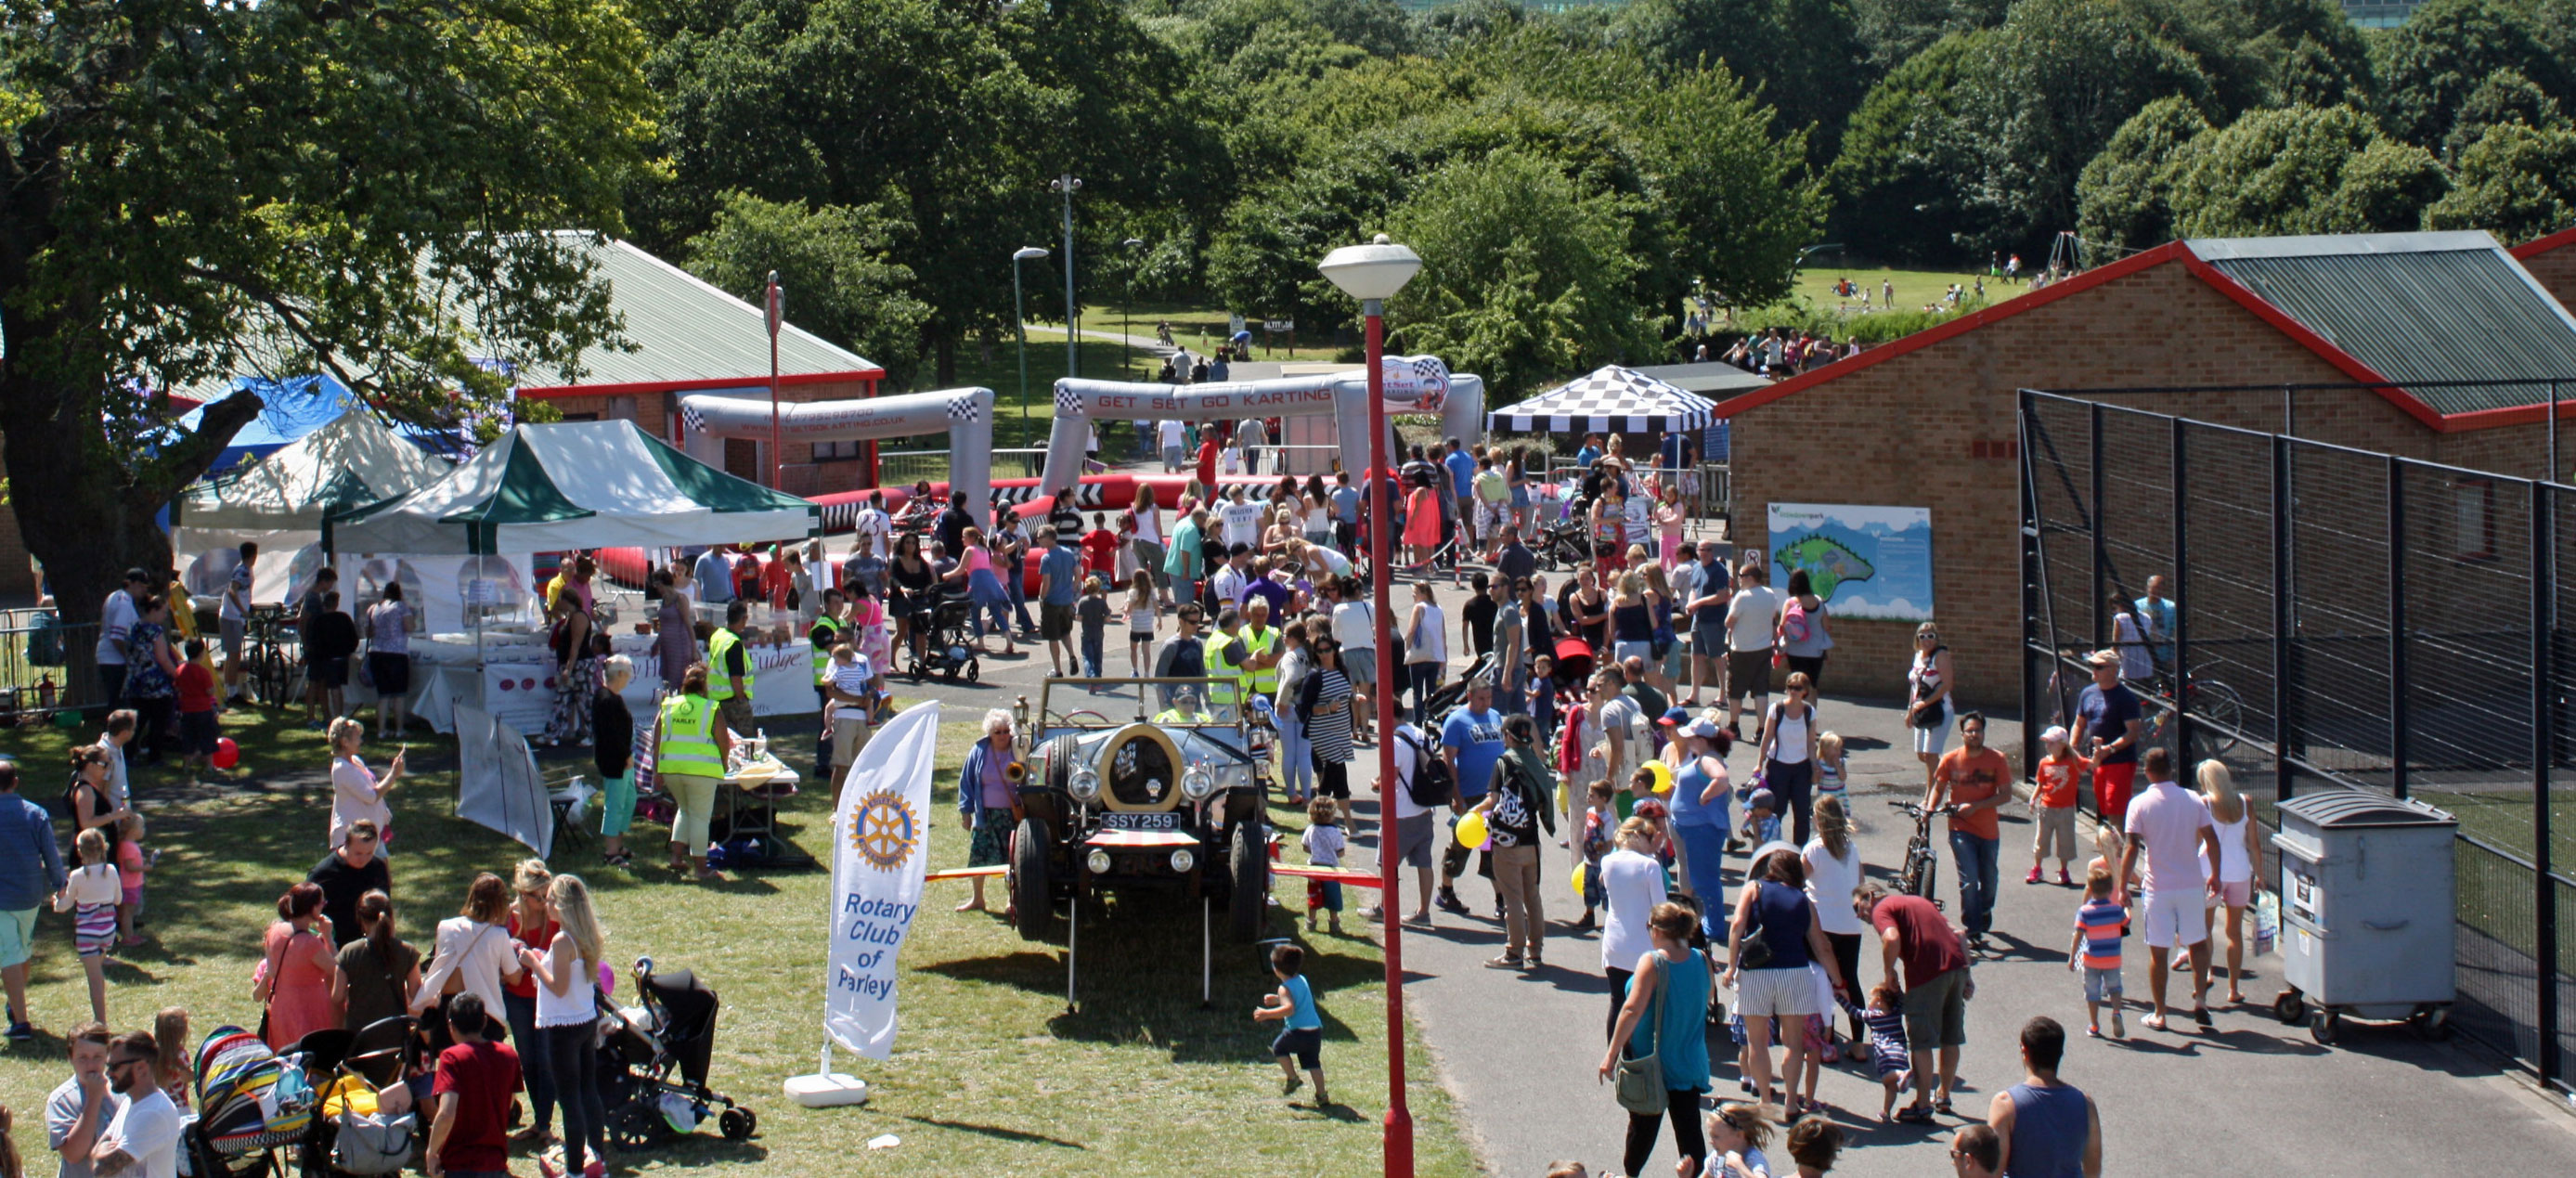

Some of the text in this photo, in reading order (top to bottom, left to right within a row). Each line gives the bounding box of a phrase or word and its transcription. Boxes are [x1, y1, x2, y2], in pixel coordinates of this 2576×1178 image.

[1099, 388, 1331, 410] GET SET GO KARTING
[861, 513, 881, 536] 23
[1224, 587, 1230, 596] 5
[749, 652, 802, 672] Fudge.
[1107, 814, 1172, 828] SSY 259
[844, 892, 917, 925] Rotary
[849, 920, 900, 945] Club
[858, 950, 885, 968] of
[837, 968, 893, 1001] Parley
